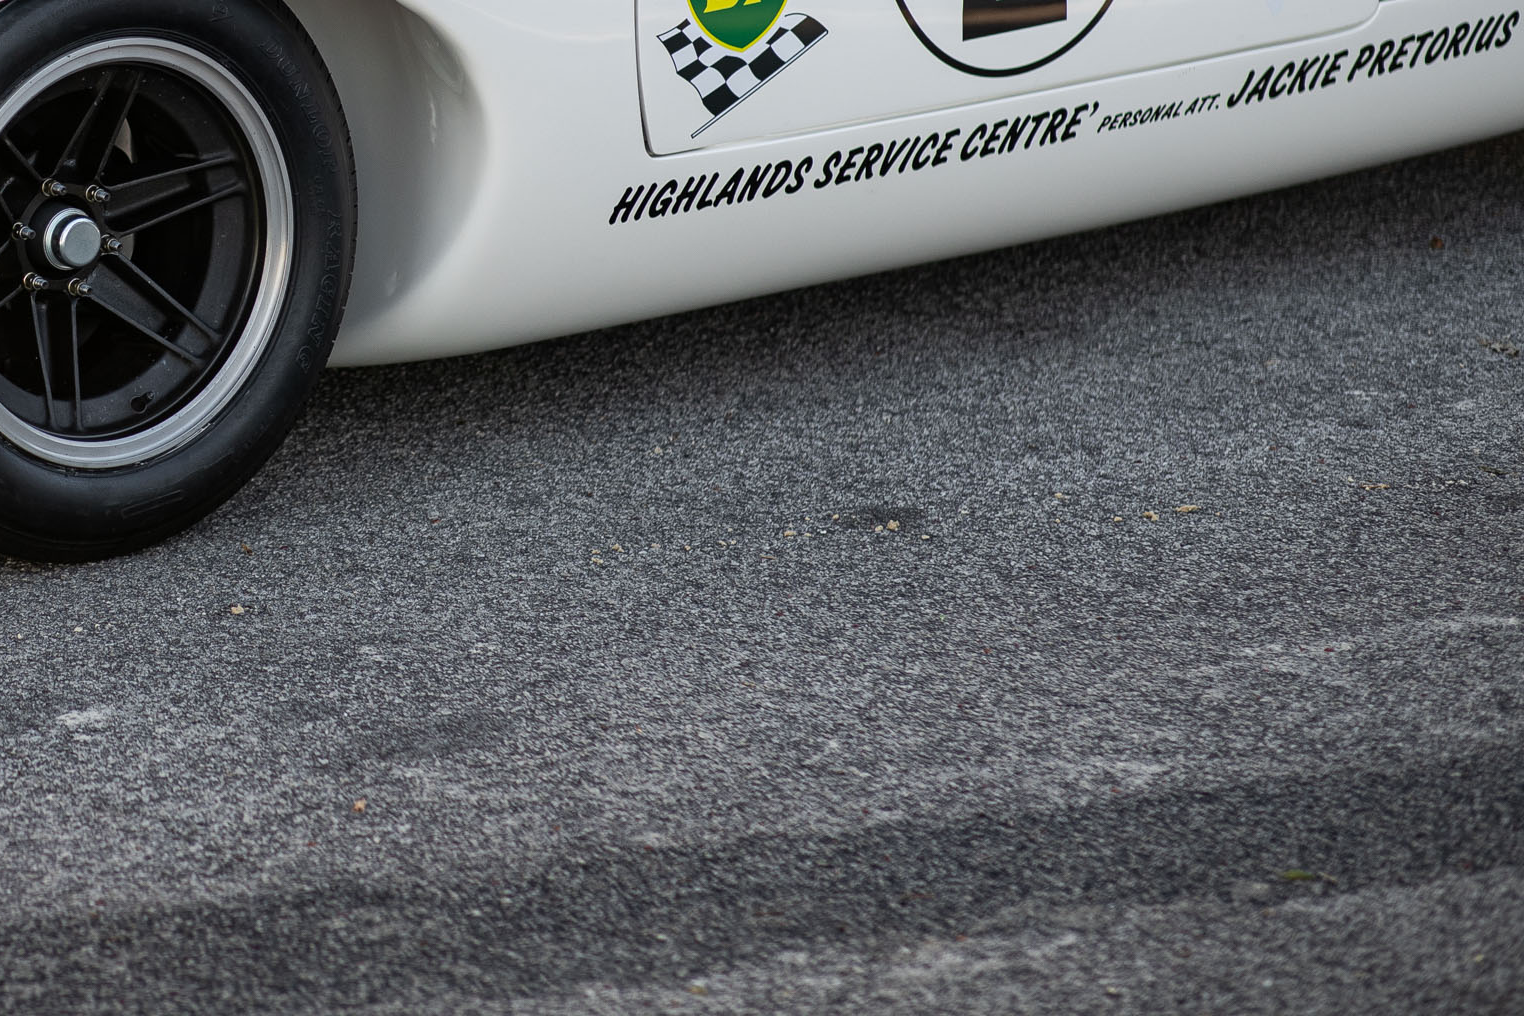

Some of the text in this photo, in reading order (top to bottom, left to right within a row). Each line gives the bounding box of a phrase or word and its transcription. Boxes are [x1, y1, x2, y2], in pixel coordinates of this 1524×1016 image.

[609, 155, 813, 226] HIGHLANDS
[814, 129, 961, 190] SERVICE
[1096, 100, 1184, 134] PERSONAL
[1184, 93, 1223, 116] ATT.
[1227, 50, 1349, 109] JACKIE
[1347, 10, 1520, 83] PRETORIUS
